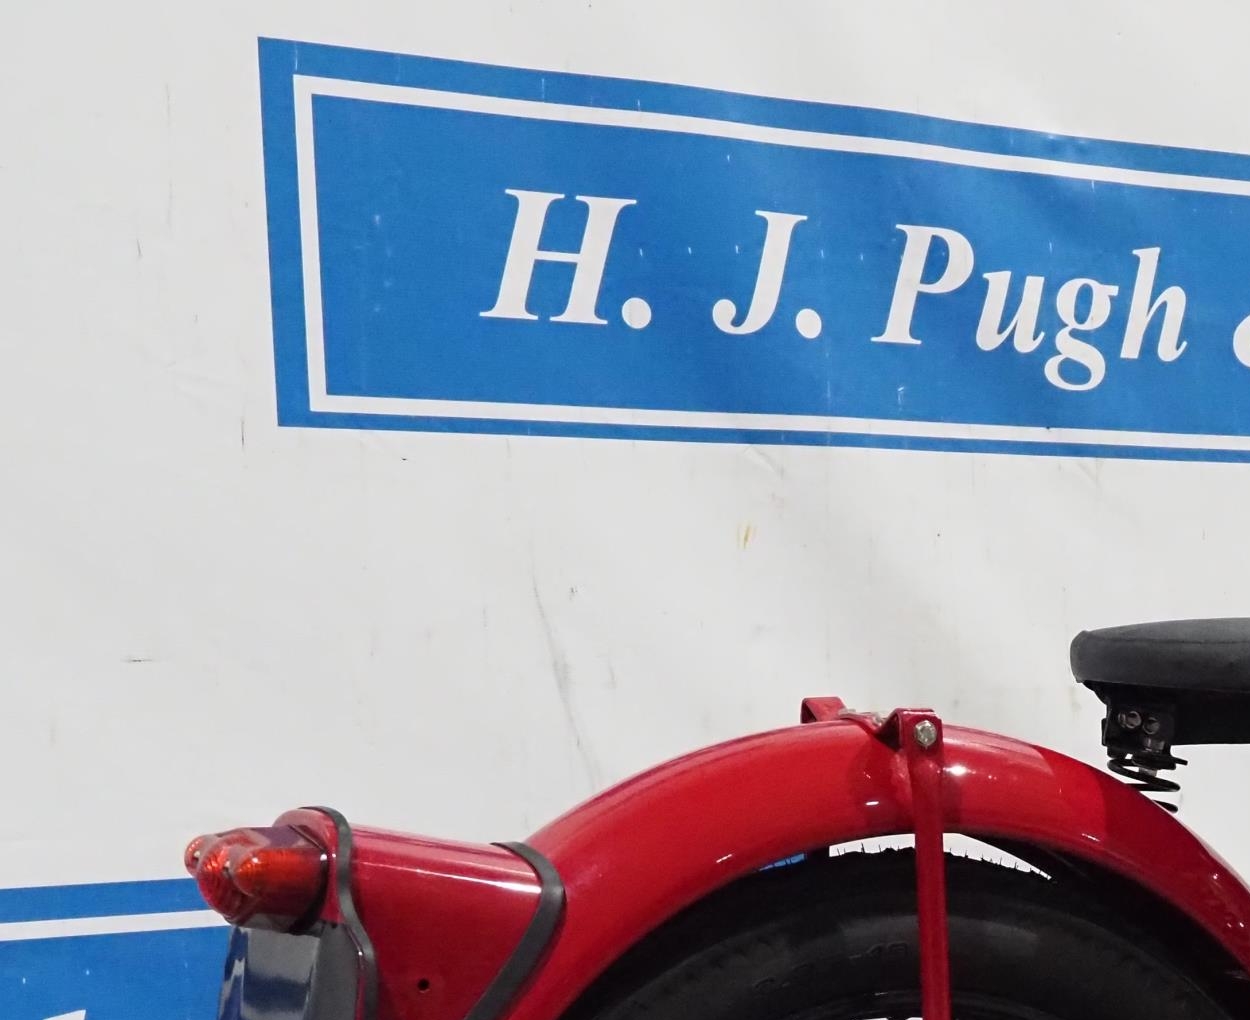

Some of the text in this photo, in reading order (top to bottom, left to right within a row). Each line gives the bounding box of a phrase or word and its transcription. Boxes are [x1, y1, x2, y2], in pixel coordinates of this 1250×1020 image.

[479, 188, 652, 329] H.
[712, 210, 822, 339] J.
[870, 224, 1188, 391] Pugh
